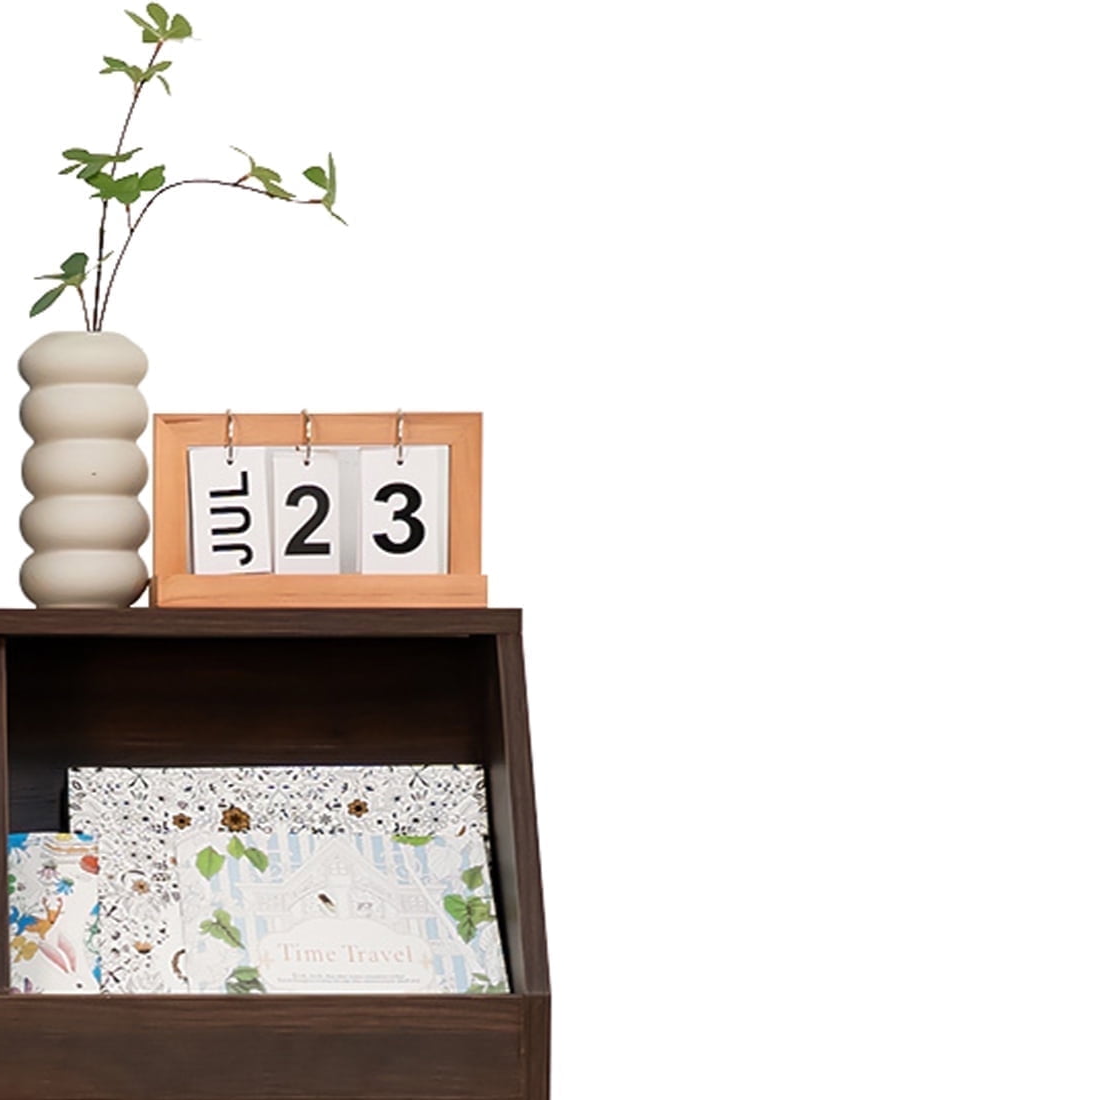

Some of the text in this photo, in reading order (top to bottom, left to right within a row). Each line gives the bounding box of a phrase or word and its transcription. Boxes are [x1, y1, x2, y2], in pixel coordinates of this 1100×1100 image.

[209, 471, 254, 565] JUL
[284, 484, 331, 556] 2
[372, 482, 426, 555] 3
[277, 943, 413, 963] Time Travel
